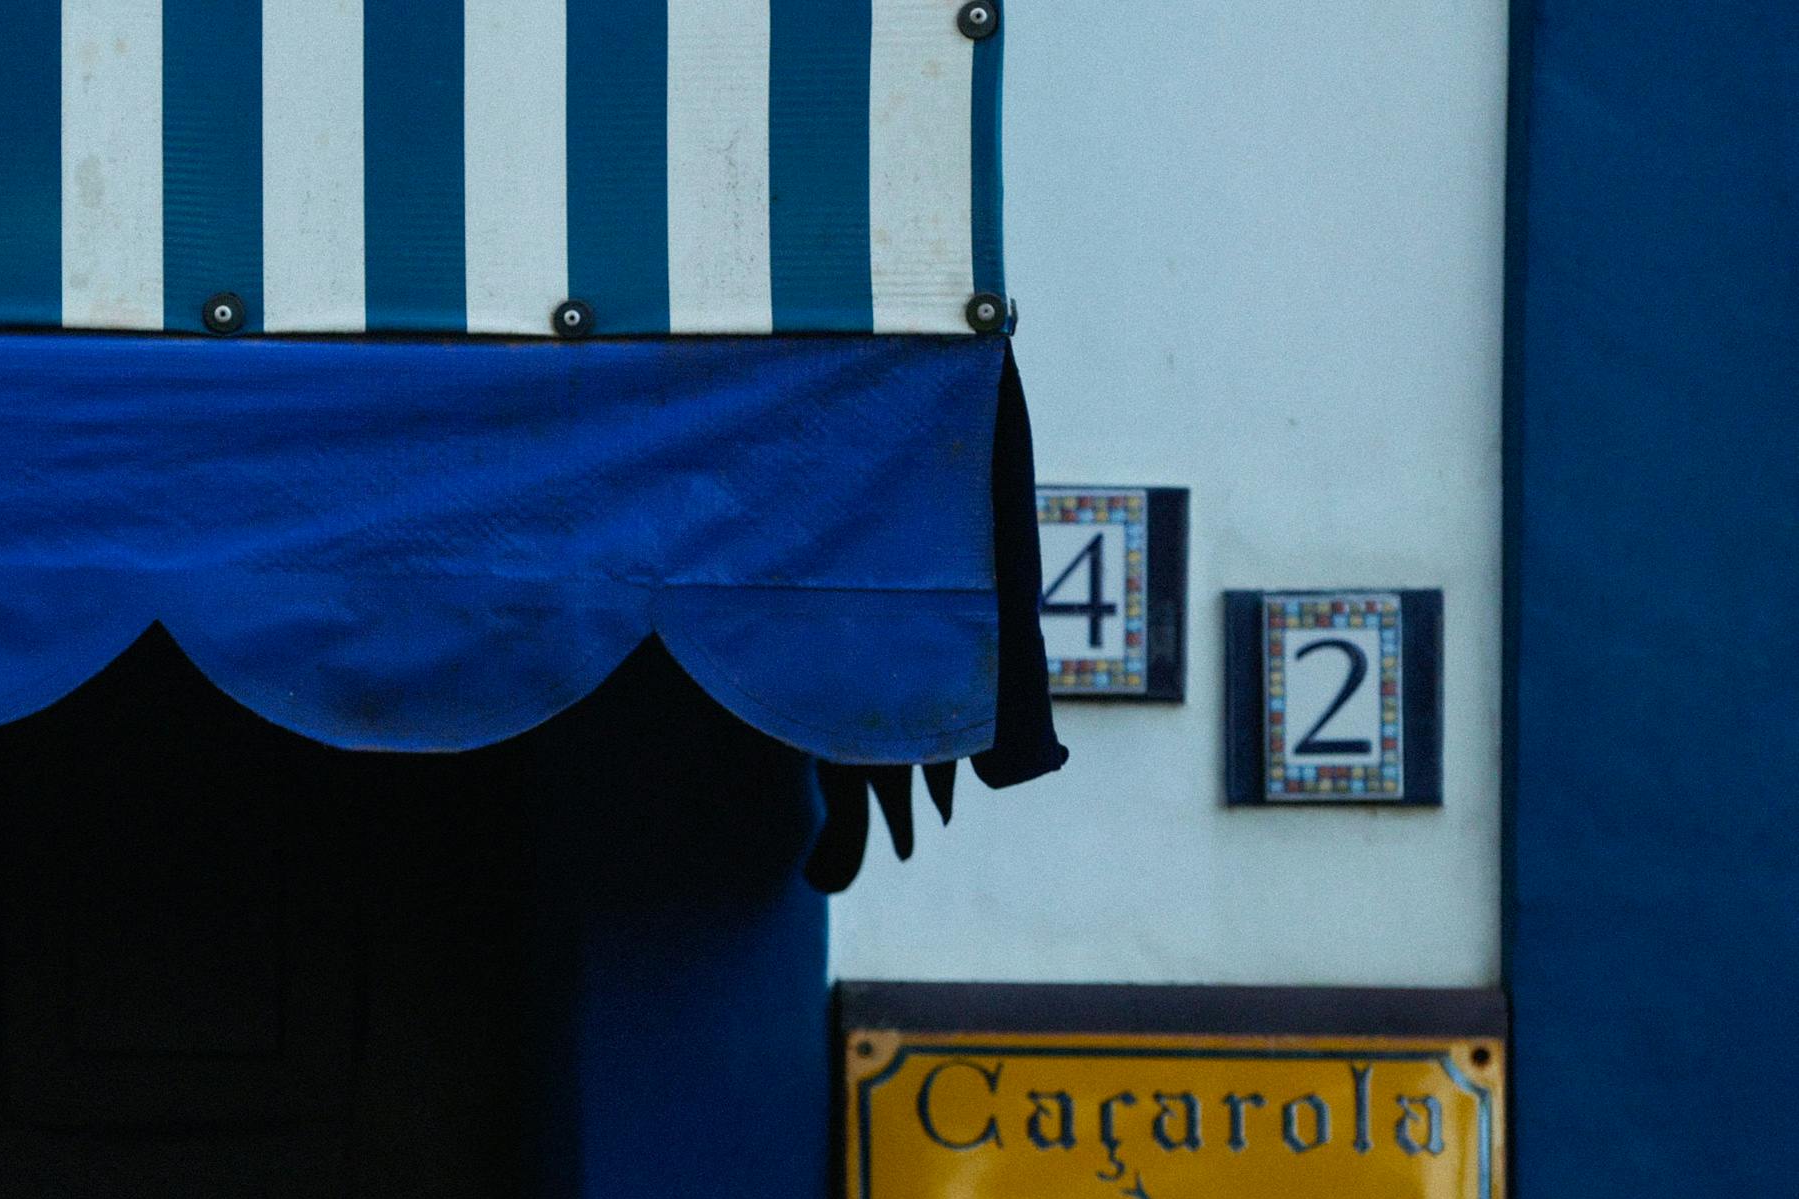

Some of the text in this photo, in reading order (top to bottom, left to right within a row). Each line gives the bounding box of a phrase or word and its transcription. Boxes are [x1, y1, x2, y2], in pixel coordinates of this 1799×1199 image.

[1039, 531, 1117, 649] 4
[1293, 637, 1373, 756] 2
[915, 1060, 1446, 1181] Caçarola
